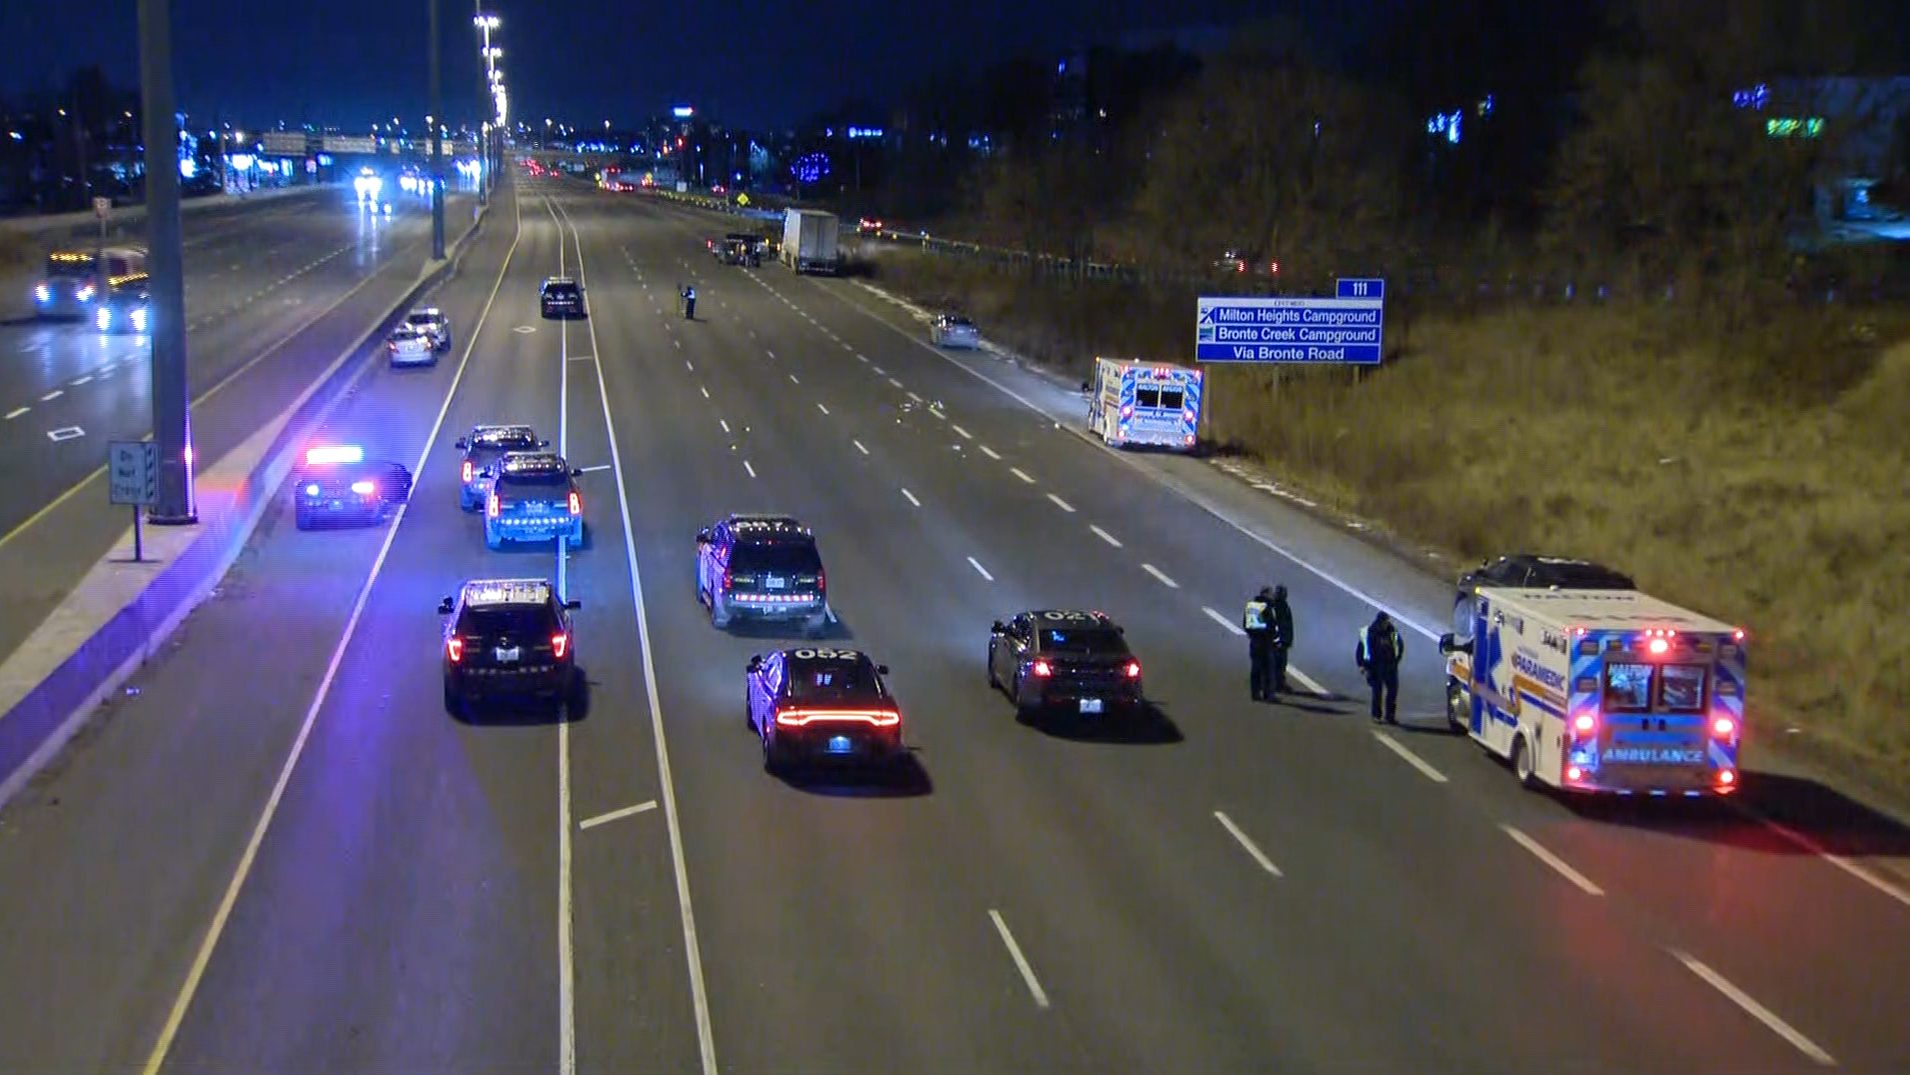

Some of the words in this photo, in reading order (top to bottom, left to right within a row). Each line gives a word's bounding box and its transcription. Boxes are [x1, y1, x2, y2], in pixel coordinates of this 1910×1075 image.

[1353, 282, 1368, 296] 111
[1219, 308, 1254, 321] Milton
[1257, 309, 1300, 324] Heights
[1303, 309, 1377, 325] Campground
[1218, 327, 1258, 340] Bronte
[1261, 327, 1296, 340] Creek
[1299, 328, 1376, 343] Campground
[1233, 346, 1254, 359] Via
[1258, 347, 1304, 360] Bronte
[1308, 347, 1345, 360] Road
[794, 648, 857, 659] 052
[1515, 653, 1566, 692] PARAMEDIC
[1602, 748, 1703, 763] AMBULANCE
